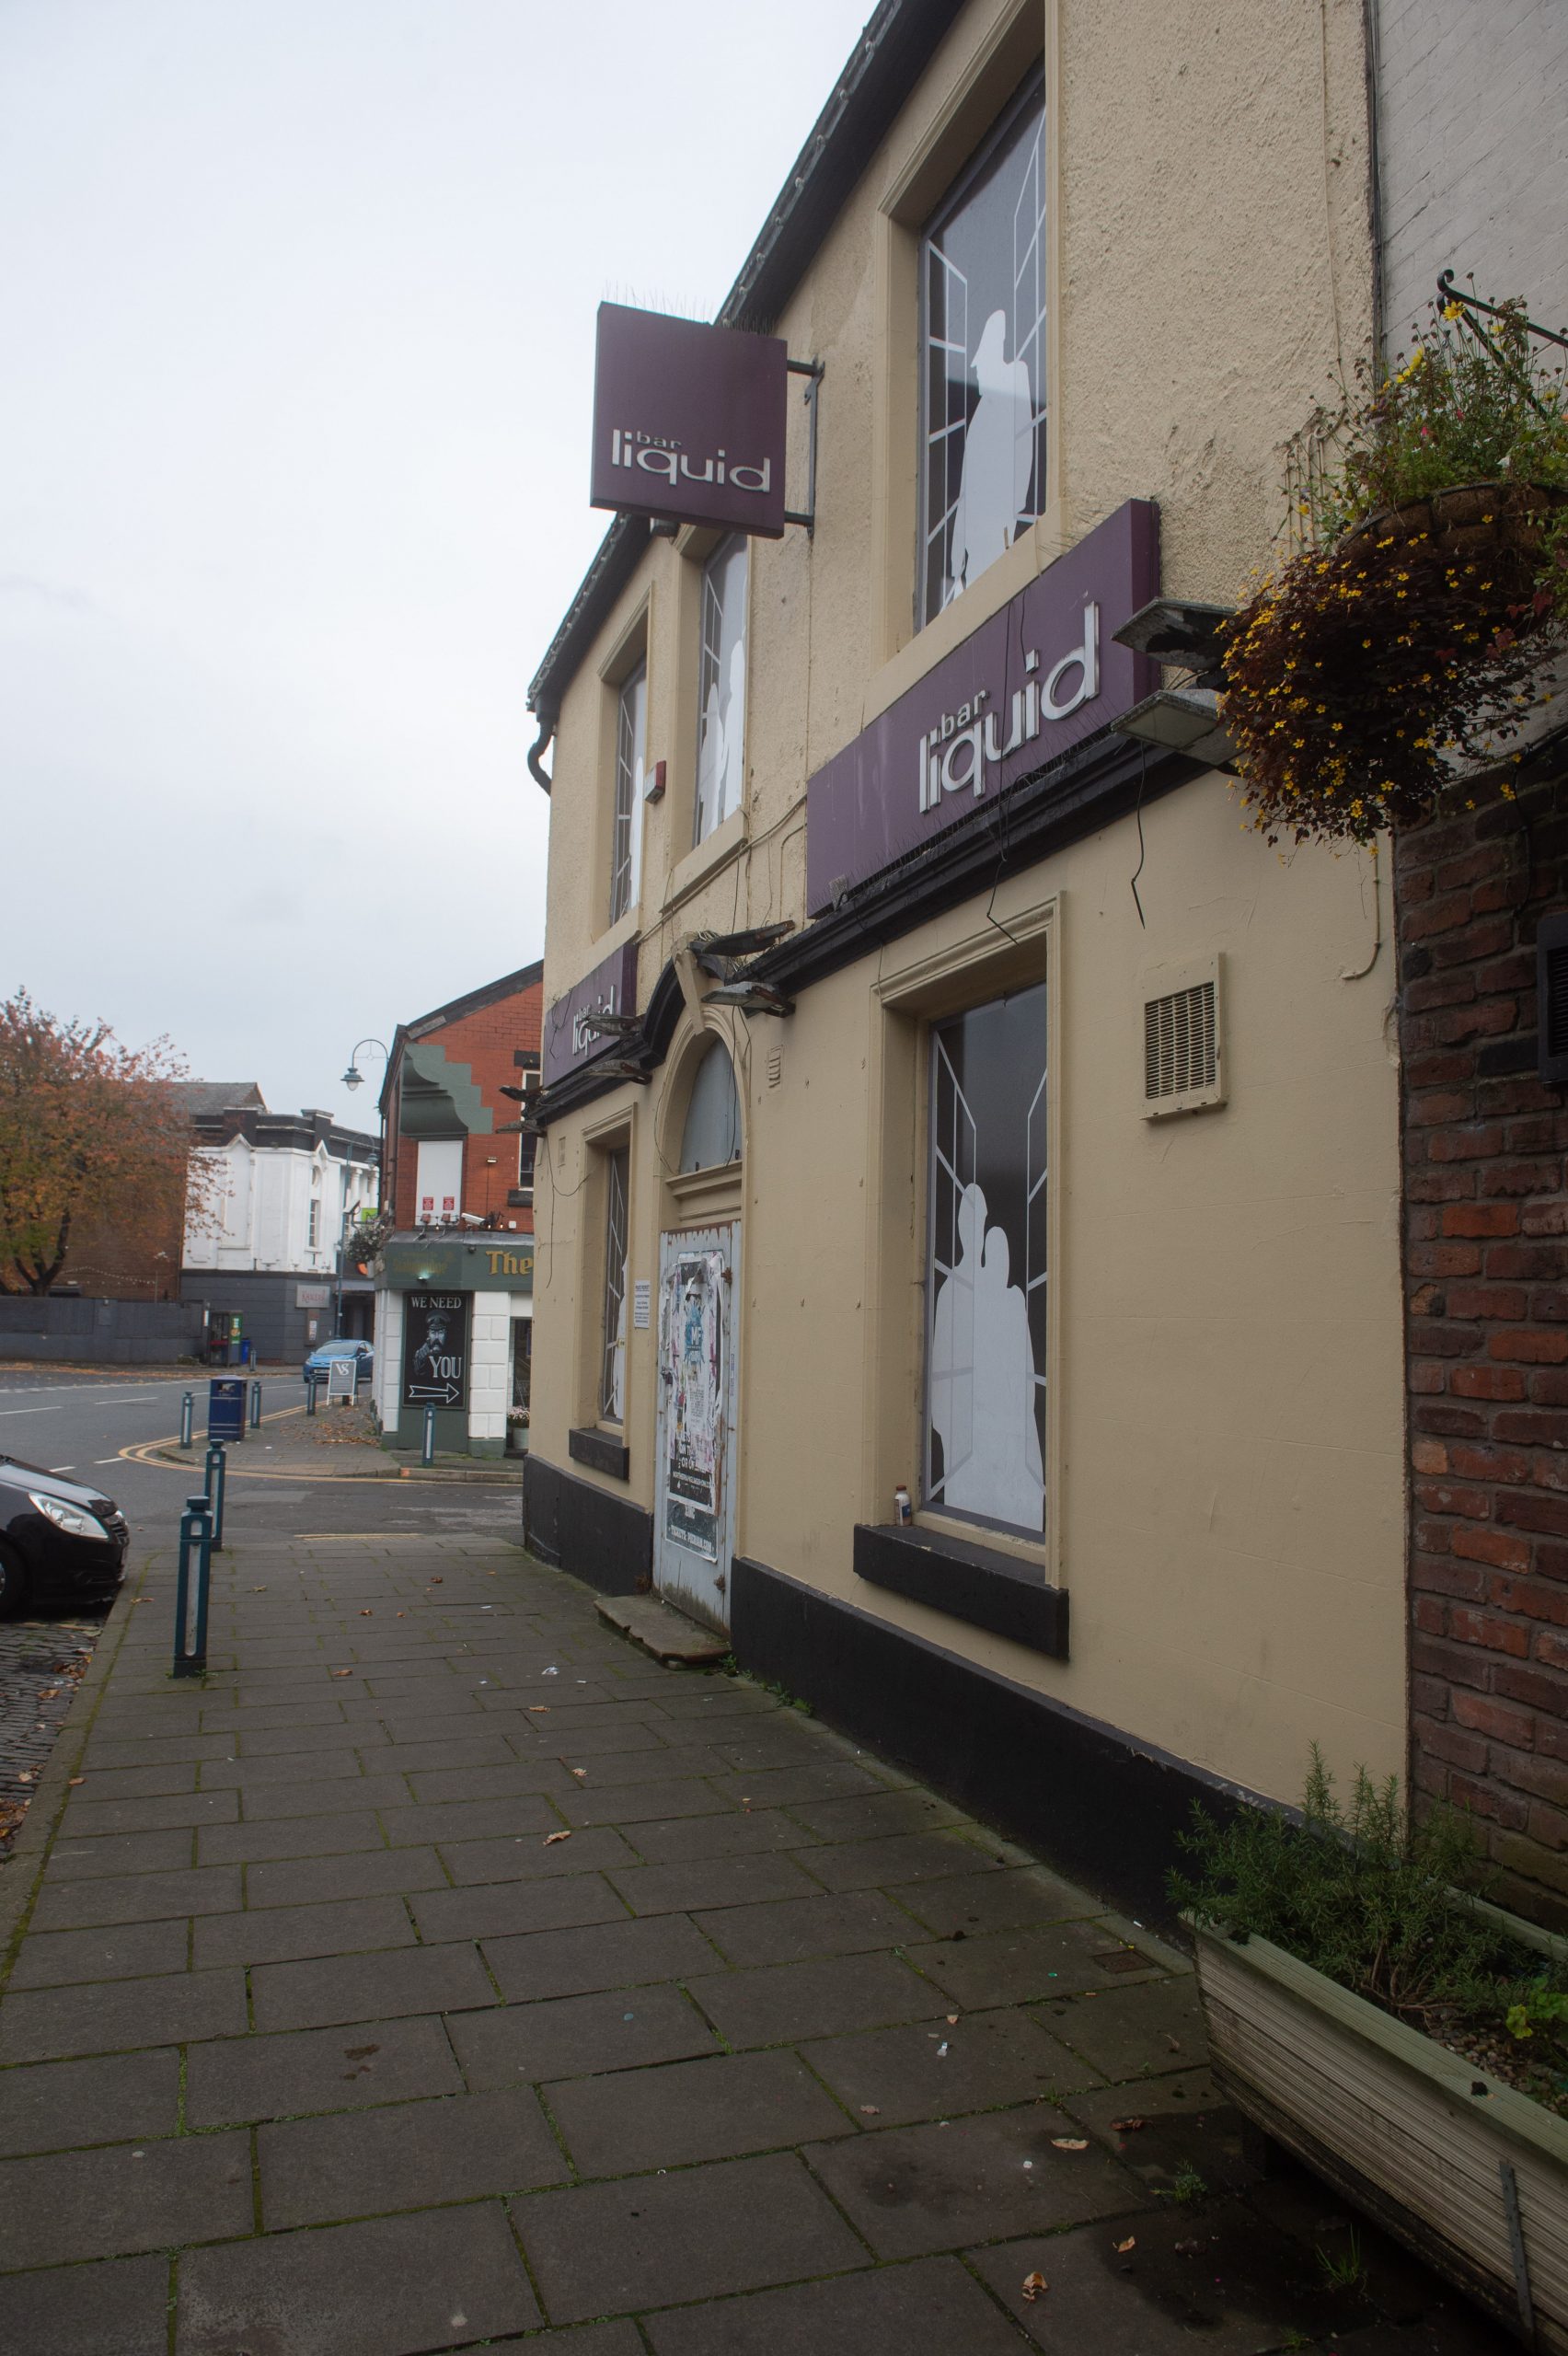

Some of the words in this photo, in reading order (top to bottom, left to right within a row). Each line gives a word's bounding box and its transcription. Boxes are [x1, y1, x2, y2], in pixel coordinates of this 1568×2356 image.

[636, 430, 682, 450] bar
[612, 429, 771, 493] liquid
[919, 600, 1100, 814] liquid
[941, 689, 989, 741] bar
[486, 1250, 534, 1276] The
[410, 1296, 428, 1308] WE
[430, 1297, 462, 1309] NEED
[429, 1356, 462, 1379] YOU
